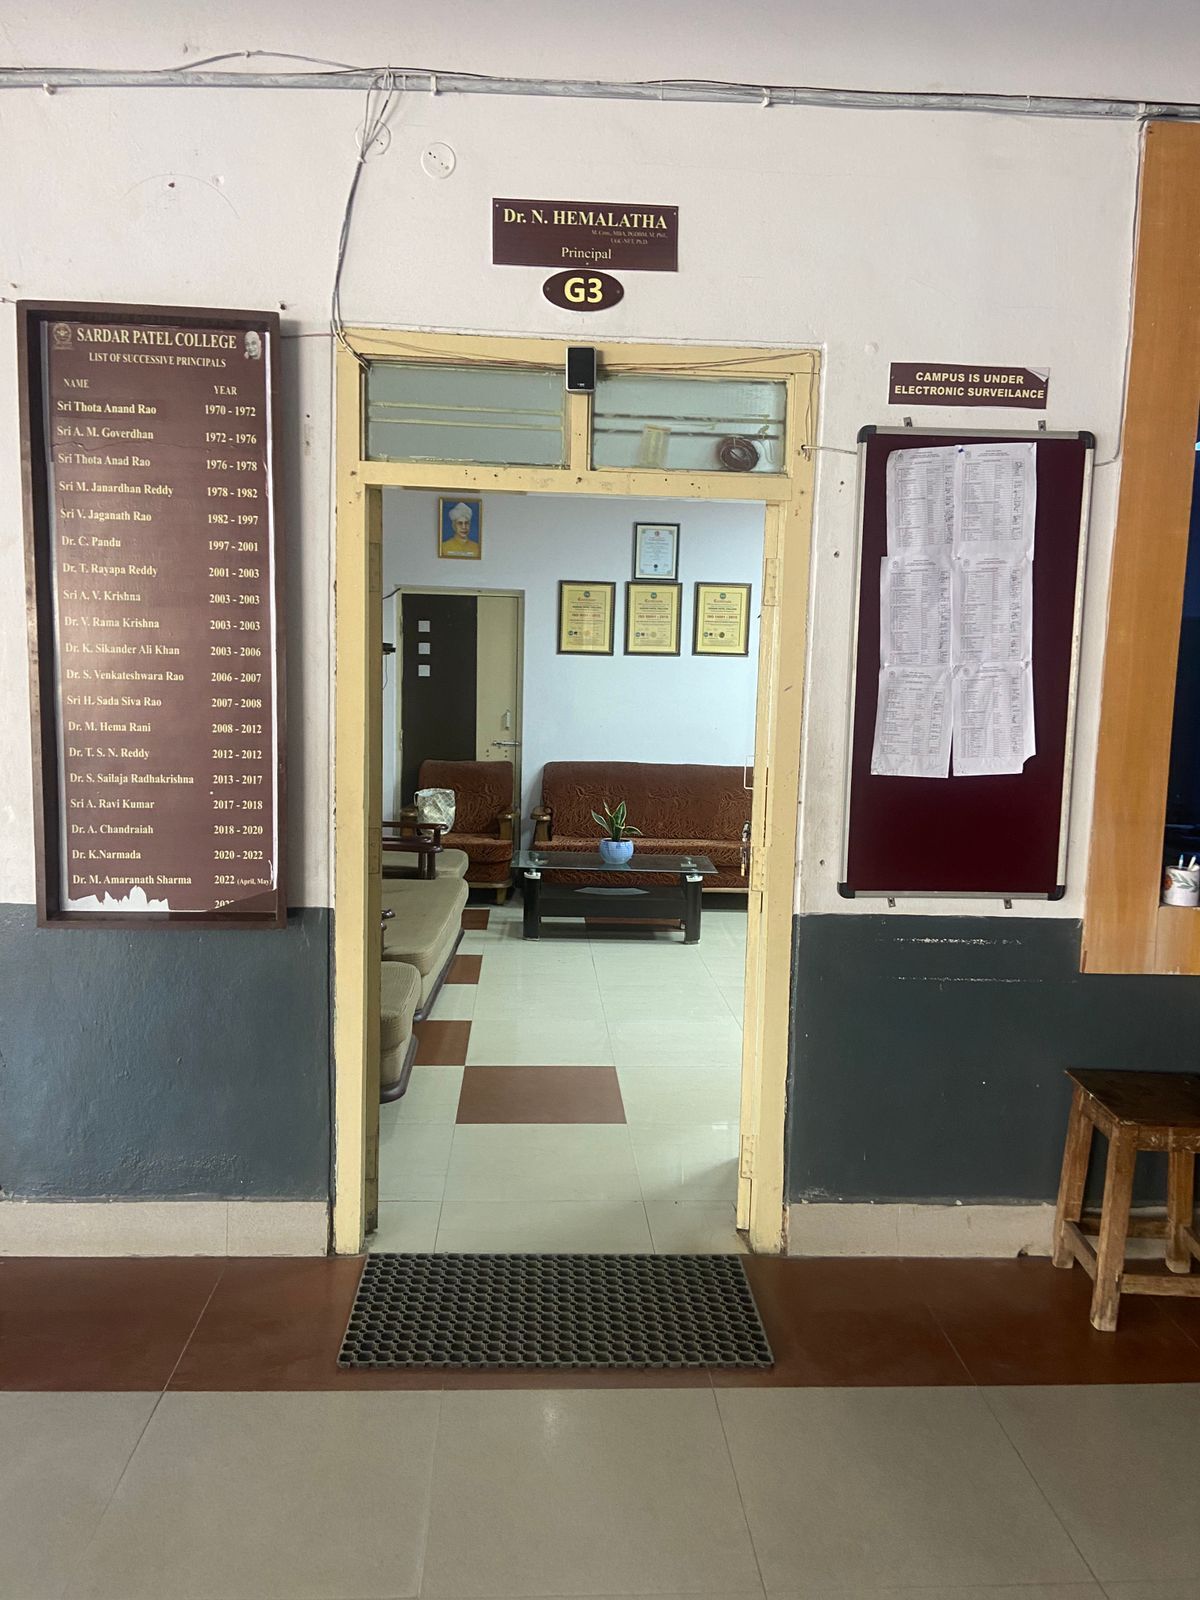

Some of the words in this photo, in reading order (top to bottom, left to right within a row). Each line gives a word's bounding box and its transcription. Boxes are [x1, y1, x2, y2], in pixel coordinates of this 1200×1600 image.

[504, 208, 527, 223] Dr.
[531, 210, 548, 224] N.
[554, 210, 667, 229] HEMALATHA
[562, 247, 611, 261] Principal
[564, 277, 603, 303] G3
[77, 328, 130, 343] SARDAR
[133, 330, 173, 346] PATEL
[175, 331, 237, 349] COLLEGE
[89, 352, 108, 362] LIST
[109, 353, 121, 362] OF
[122, 354, 174, 365] SUCCESSIVE
[176, 356, 226, 368] PRINCIPALS
[64, 378, 89, 388] NAME
[916, 372, 965, 382] CAMPUS
[969, 374, 980, 383] IS
[984, 374, 1024, 384] UNDER
[214, 385, 237, 395] YEAR
[895, 385, 964, 396] ELECTRONIC
[968, 388, 1044, 398] SURVEILANCE
[57, 401, 72, 411] Sri
[74, 401, 102, 412] Thota
[104, 404, 136, 414] Anand
[138, 404, 156, 414] Rao
[205, 404, 226, 415] 1970
[235, 406, 256, 417] 1972
[57, 426, 71, 436] Sri
[74, 427, 84, 436] A.
[86, 426, 100, 437] M.
[101, 427, 154, 439] Goverdhan
[206, 432, 226, 443] 1972
[236, 434, 257, 444] 1976
[58, 453, 72, 463] Sri
[74, 454, 102, 464] Thota
[104, 456, 129, 466] Anad
[132, 456, 151, 467] Rao
[206, 460, 228, 470] 1976
[236, 461, 257, 471] 1978
[59, 481, 73, 491] Sri
[76, 482, 89, 491] M.
[91, 482, 141, 494] Janardhan
[144, 484, 174, 498] Reddy
[207, 487, 228, 497] 1978
[237, 488, 258, 498] 1982
[60, 508, 74, 518] Sri
[76, 509, 86, 519] V.
[88, 509, 130, 522] Jaganath
[133, 511, 152, 521] Rao
[208, 514, 229, 524] 1982
[238, 515, 258, 525] 1997
[62, 536, 76, 545] Dr.
[78, 536, 89, 546] C.
[92, 536, 121, 547] Pandu
[209, 541, 230, 551] 1997
[238, 541, 258, 552] 2001
[63, 563, 77, 573] Dr.
[79, 563, 89, 573] T.
[91, 564, 126, 576] Rayapa
[128, 565, 157, 577] Reddy
[209, 567, 229, 577] 2001
[238, 568, 260, 578] 2003
[63, 590, 77, 599] Sri
[92, 590, 101, 600] V.
[104, 590, 141, 601] Krishna
[209, 594, 230, 604] 2003
[239, 594, 260, 604] 2003
[65, 616, 78, 626] Dr.
[81, 616, 90, 626] V.
[93, 617, 120, 627] Rama
[123, 618, 160, 628] Krishna
[210, 620, 231, 630] 2003
[239, 621, 260, 630] 2003
[66, 643, 79, 652] Dr.
[83, 643, 93, 653] K.
[96, 644, 137, 654] Sikander
[138, 644, 152, 654] Ali
[155, 645, 180, 655] Khan
[211, 646, 232, 656] 2003
[240, 647, 261, 656] 2006
[66, 669, 80, 679] Dr.
[83, 670, 92, 679] S.
[94, 670, 163, 680] Venkateshwara
[166, 671, 184, 681] Rao
[211, 672, 232, 682] 2006
[240, 673, 262, 683] 2007
[67, 695, 81, 705] Sri
[97, 696, 119, 705] Sada
[121, 696, 141, 706] Siva
[144, 696, 162, 707] Rao
[212, 698, 232, 708] 2007
[241, 698, 262, 708] 2008
[68, 721, 82, 731] Dr.
[85, 721, 98, 731] M.
[100, 722, 127, 732] Hema
[129, 722, 151, 732] Rani
[212, 724, 233, 733] 2008
[241, 724, 262, 734] 2012
[69, 747, 83, 757] Dr.
[85, 747, 94, 757] T.
[96, 747, 106, 757] S.
[108, 748, 118, 757] N.
[121, 748, 150, 760] Reddy
[212, 749, 233, 759] 2012
[241, 750, 262, 759] 2012
[70, 773, 84, 782] Dr.
[86, 773, 95, 783] S.
[97, 773, 128, 785] Sailaja
[131, 774, 194, 784] Radhakrishna
[213, 775, 234, 784] 2013
[242, 775, 263, 784] 2017
[70, 798, 84, 808] Sri
[86, 800, 96, 808] A.
[99, 799, 120, 808] Ravi
[123, 799, 155, 808] Kumar
[213, 800, 234, 809] 2017
[242, 800, 263, 810] 2018
[72, 824, 86, 834] Dr.
[87, 825, 98, 834] A.
[100, 824, 154, 834] Chandraiah
[214, 825, 234, 834] 2018
[242, 825, 263, 835] 2020
[72, 850, 86, 859] Dr.
[214, 850, 235, 859] 2020
[243, 850, 263, 860] 2022
[73, 874, 87, 884] Dr.
[89, 875, 102, 884] M.
[103, 875, 154, 884] Amaranath
[156, 875, 192, 884] Sharma
[214, 875, 235, 884] 2022
